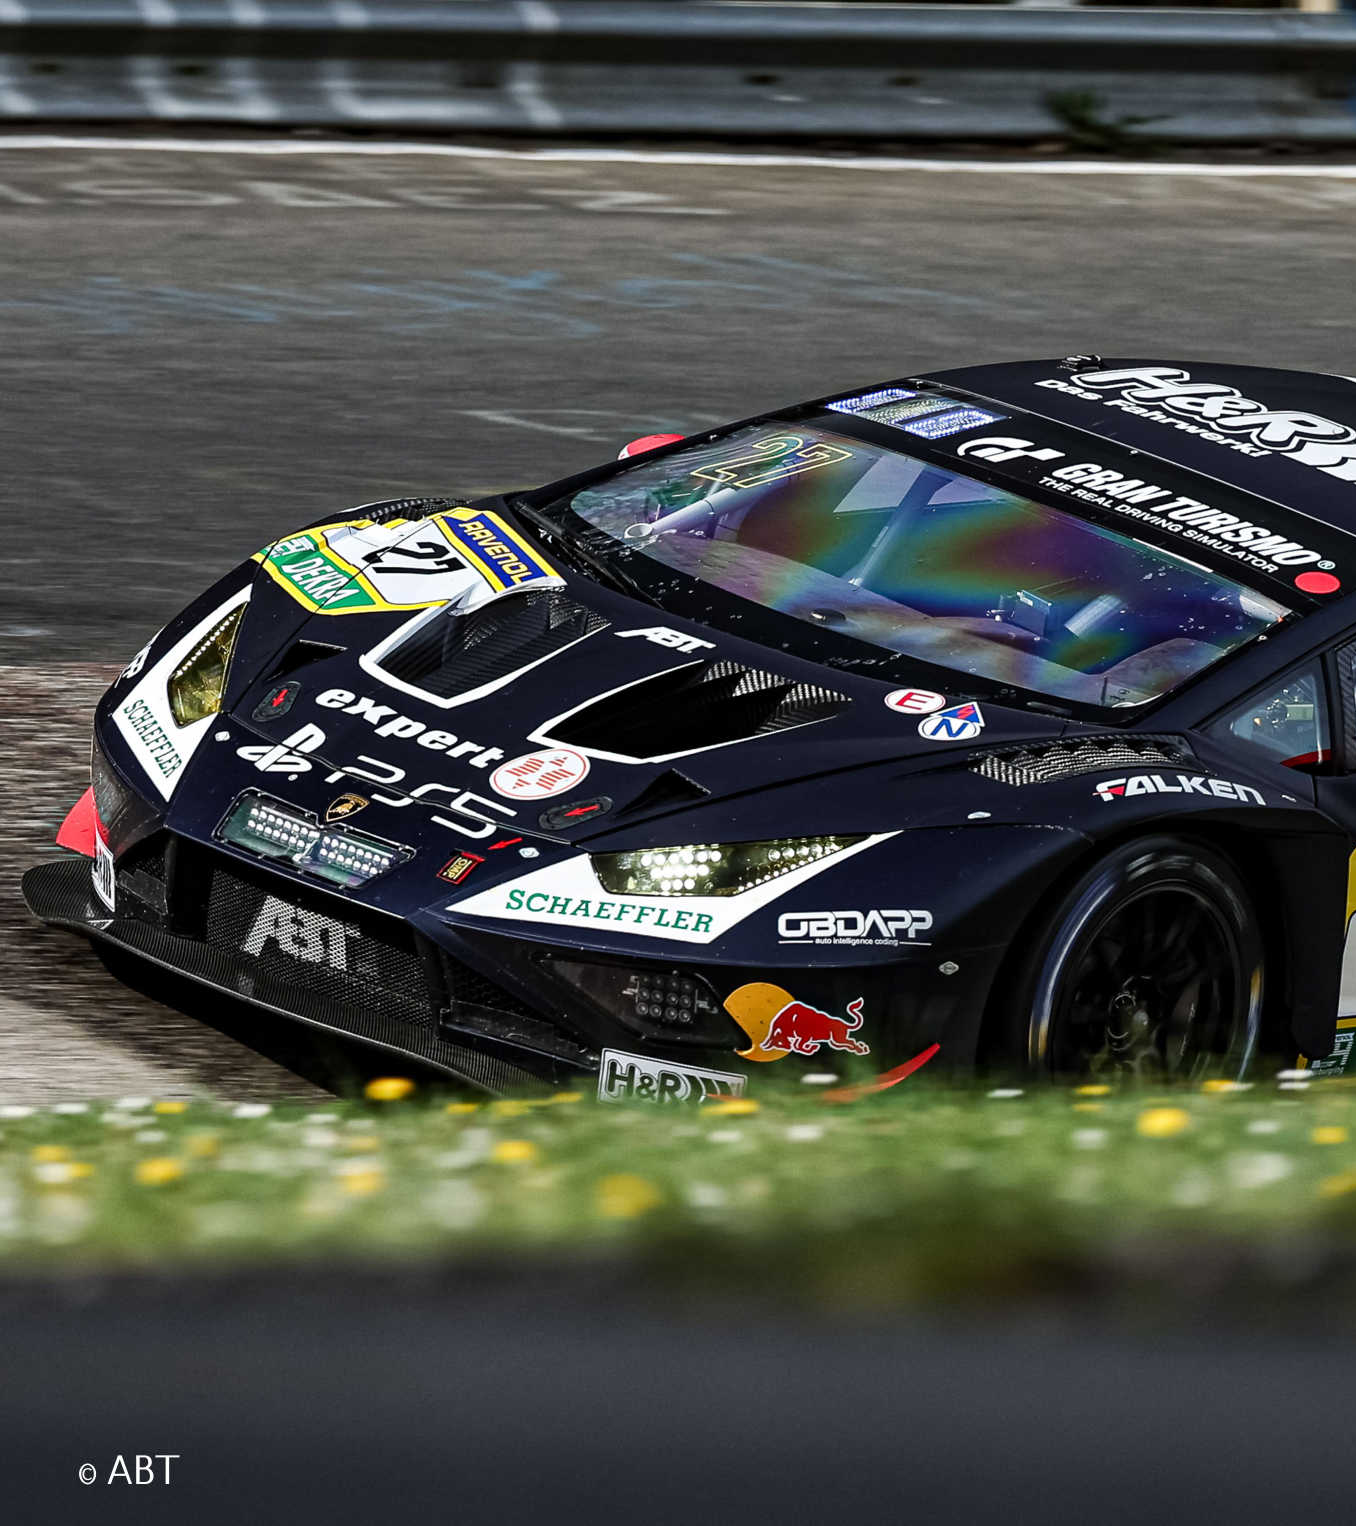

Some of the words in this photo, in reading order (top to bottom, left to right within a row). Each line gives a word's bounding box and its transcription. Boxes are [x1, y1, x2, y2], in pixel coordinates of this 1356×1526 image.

[1034, 379, 1103, 401] Das
[1103, 399, 1273, 458] Fahrwerk!
[689, 436, 853, 489] 27
[1038, 476, 1075, 493] THE
[1070, 487, 1114, 508] REAL
[1114, 502, 1184, 533] DRIVING
[1182, 528, 1280, 574] SIMULATOR
[1051, 463, 1173, 505] GRAN
[1150, 496, 1322, 566] TURISMO
[361, 541, 468, 576] 27
[458, 518, 534, 586] RAVENOL
[281, 556, 361, 608] DEKRA
[614, 626, 717, 653] ABT
[895, 691, 935, 711] E
[123, 698, 183, 779] SCHAEFFLER
[314, 688, 505, 769] expert
[324, 755, 518, 839] PS5
[1092, 775, 1267, 805] FALKEN
[242, 895, 361, 972] ABT
[505, 889, 714, 934] SCHAEFFLER
[777, 909, 933, 938] OBDAPP
[832, 937, 874, 947] intelligence
